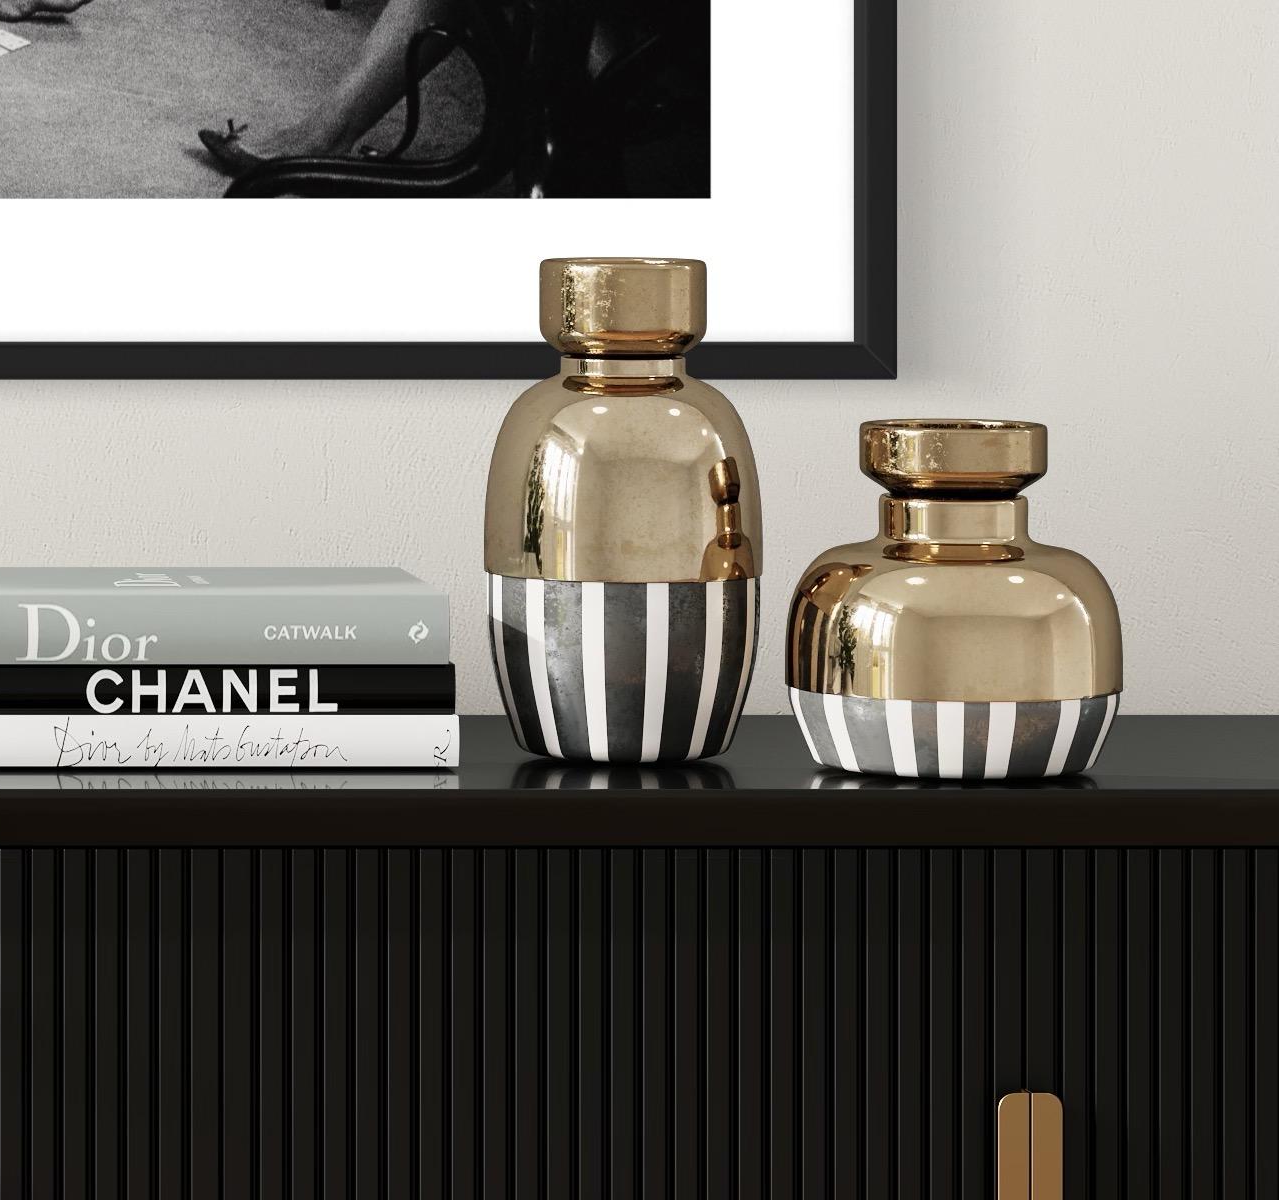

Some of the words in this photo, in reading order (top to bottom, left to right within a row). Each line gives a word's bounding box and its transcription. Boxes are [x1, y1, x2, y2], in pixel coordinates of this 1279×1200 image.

[15, 603, 159, 663] Dior
[263, 624, 358, 641] CATWALK
[85, 668, 339, 714] CHANEL
[53, 716, 132, 767] Dior
[136, 728, 170, 767] by
